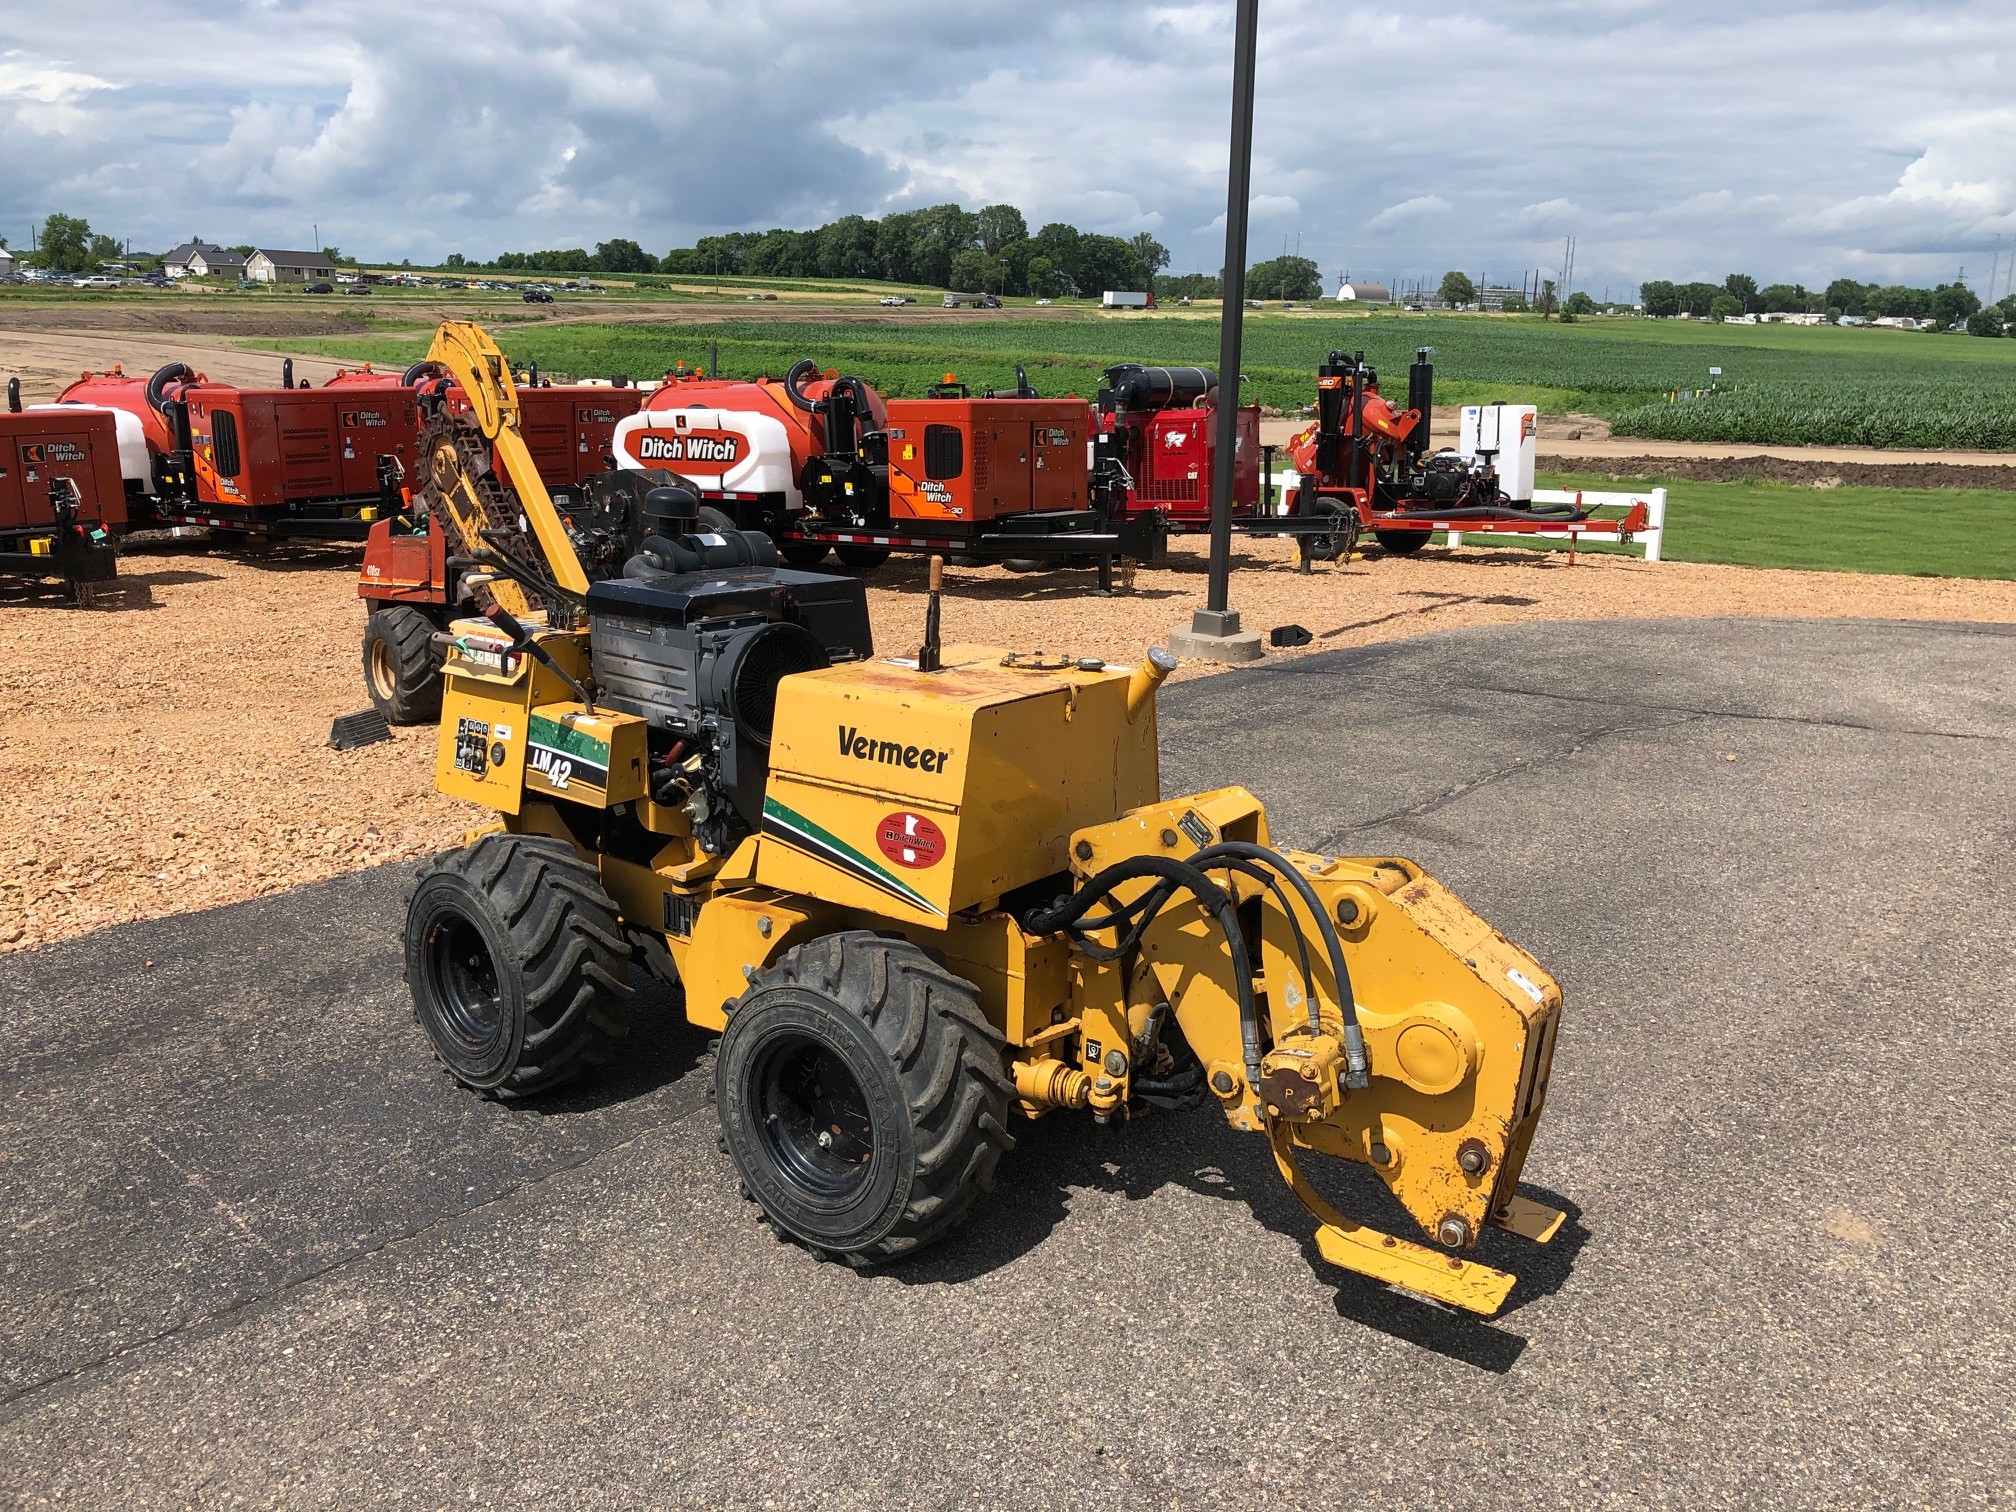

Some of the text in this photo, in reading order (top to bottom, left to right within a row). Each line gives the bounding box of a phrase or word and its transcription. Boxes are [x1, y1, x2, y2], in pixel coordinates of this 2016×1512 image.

[360, 411, 380, 419] Ditch
[365, 418, 387, 427] Witch
[1049, 428, 1065, 437] Ditch
[1052, 437, 1069, 446] Witch
[47, 443, 76, 453] Ditch
[639, 436, 736, 461] Ditch Witch
[55, 451, 85, 462] Witch
[220, 477, 234, 486] Ditch
[920, 481, 945, 492] Ditch
[224, 486, 239, 495] Witch
[926, 491, 952, 503] Witch
[838, 724, 949, 775] Vermeer
[1285, 1088, 1294, 1099] P
